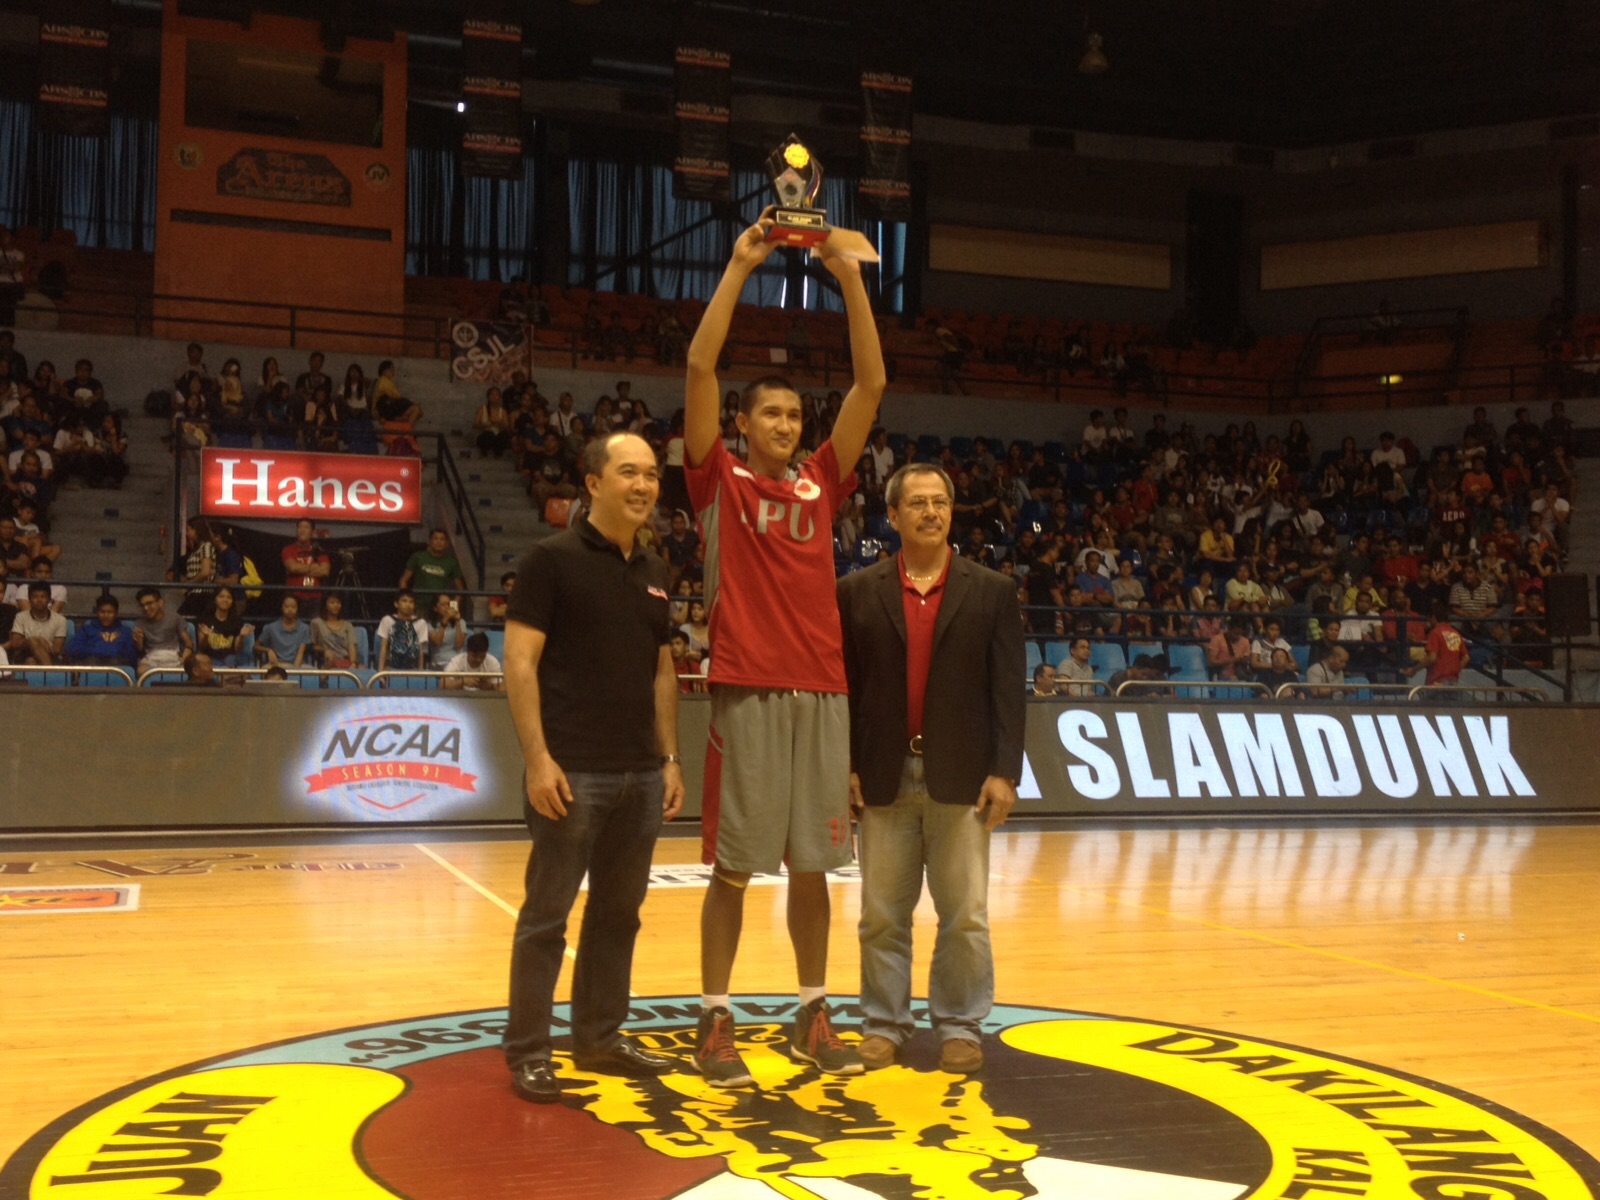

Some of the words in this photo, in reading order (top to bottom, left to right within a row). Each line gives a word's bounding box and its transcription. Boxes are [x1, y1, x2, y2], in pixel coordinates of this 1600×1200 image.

[452, 334, 516, 379] CSJL
[741, 498, 815, 543] PU
[321, 723, 461, 763] NCAA
[1056, 709, 1537, 799] SLAMDUNK
[341, 763, 407, 781] SEASON
[422, 765, 440, 778] 91
[1125, 1031, 1549, 1200] DAKILANG
[49, 1091, 279, 1197] JUAN
